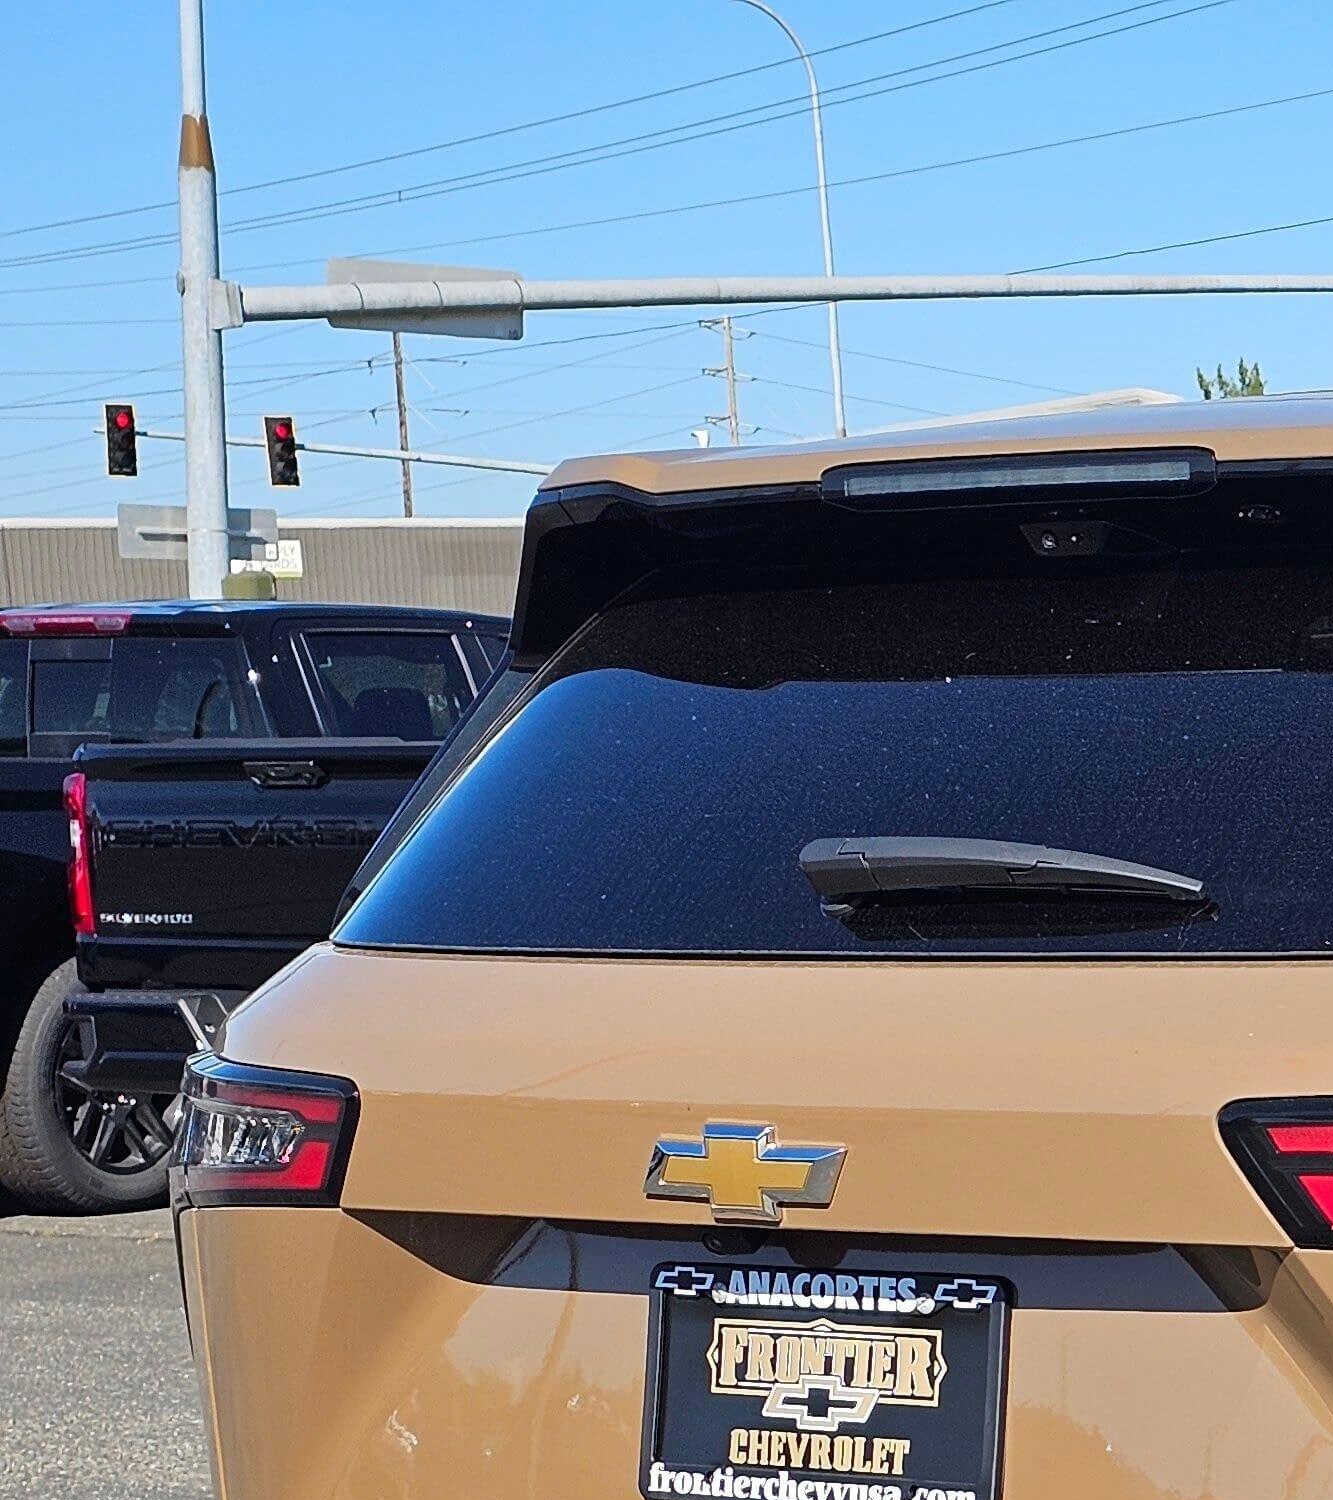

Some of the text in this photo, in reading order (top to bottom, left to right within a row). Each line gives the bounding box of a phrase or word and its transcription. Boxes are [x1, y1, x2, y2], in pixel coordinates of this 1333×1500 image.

[725, 1270, 918, 1313] ANACORTES
[719, 1326, 933, 1398] FRONTIER
[729, 1428, 910, 1475] CHEVROLET
